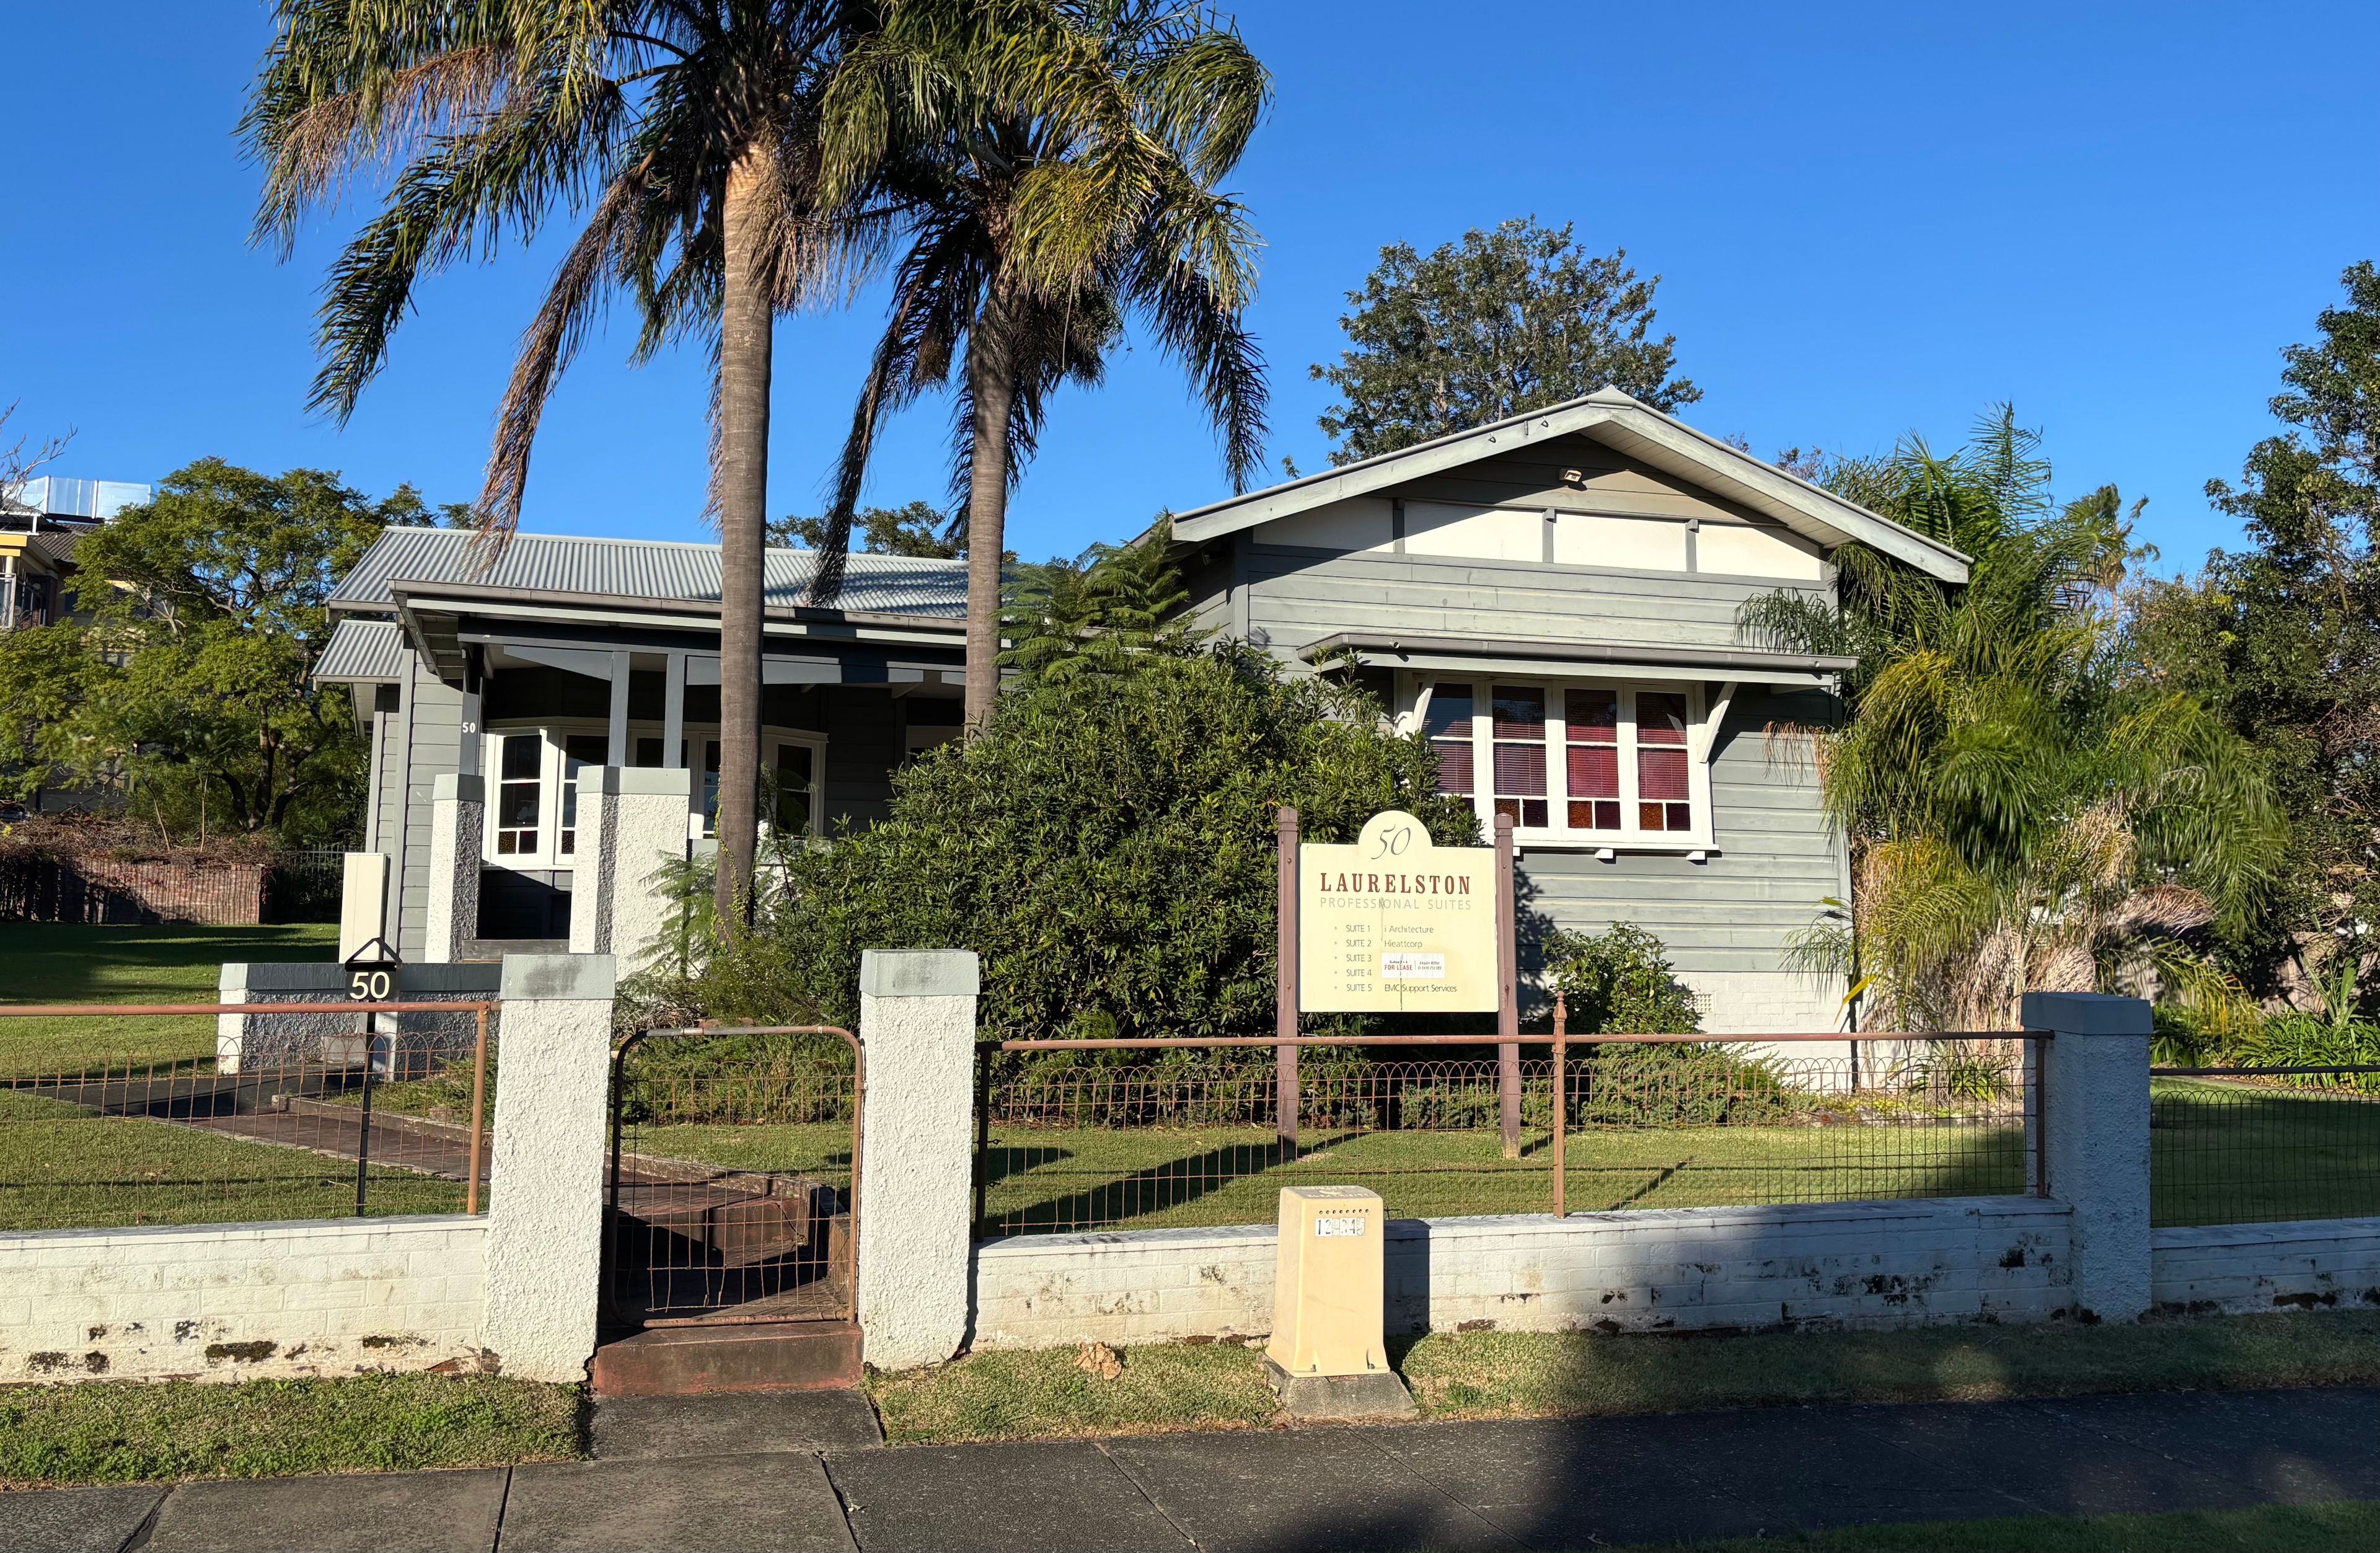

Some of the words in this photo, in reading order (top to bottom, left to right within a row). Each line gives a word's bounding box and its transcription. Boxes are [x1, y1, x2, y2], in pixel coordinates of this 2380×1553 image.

[462, 722, 476, 733] 50
[1371, 823, 1411, 860] 50
[1320, 872, 1471, 895] LAURELSTON
[1320, 897, 1420, 910] PROFESSIONAL
[1428, 900, 1471, 910] SUITES
[1346, 924, 1365, 932] SUITE
[1367, 924, 1370, 932] 1
[1389, 925, 1434, 933] Architecture
[1346, 939, 1365, 947] SUITE
[1367, 939, 1372, 947] 2
[1346, 954, 1365, 962] SUITE
[1367, 954, 1372, 962] 3
[1346, 969, 1365, 977] SUITE
[1367, 969, 1372, 977] 4
[350, 971, 390, 999] 50
[1346, 984, 1365, 992] SUITE
[1367, 984, 1372, 992] 5
[1402, 984, 1429, 993] Support
